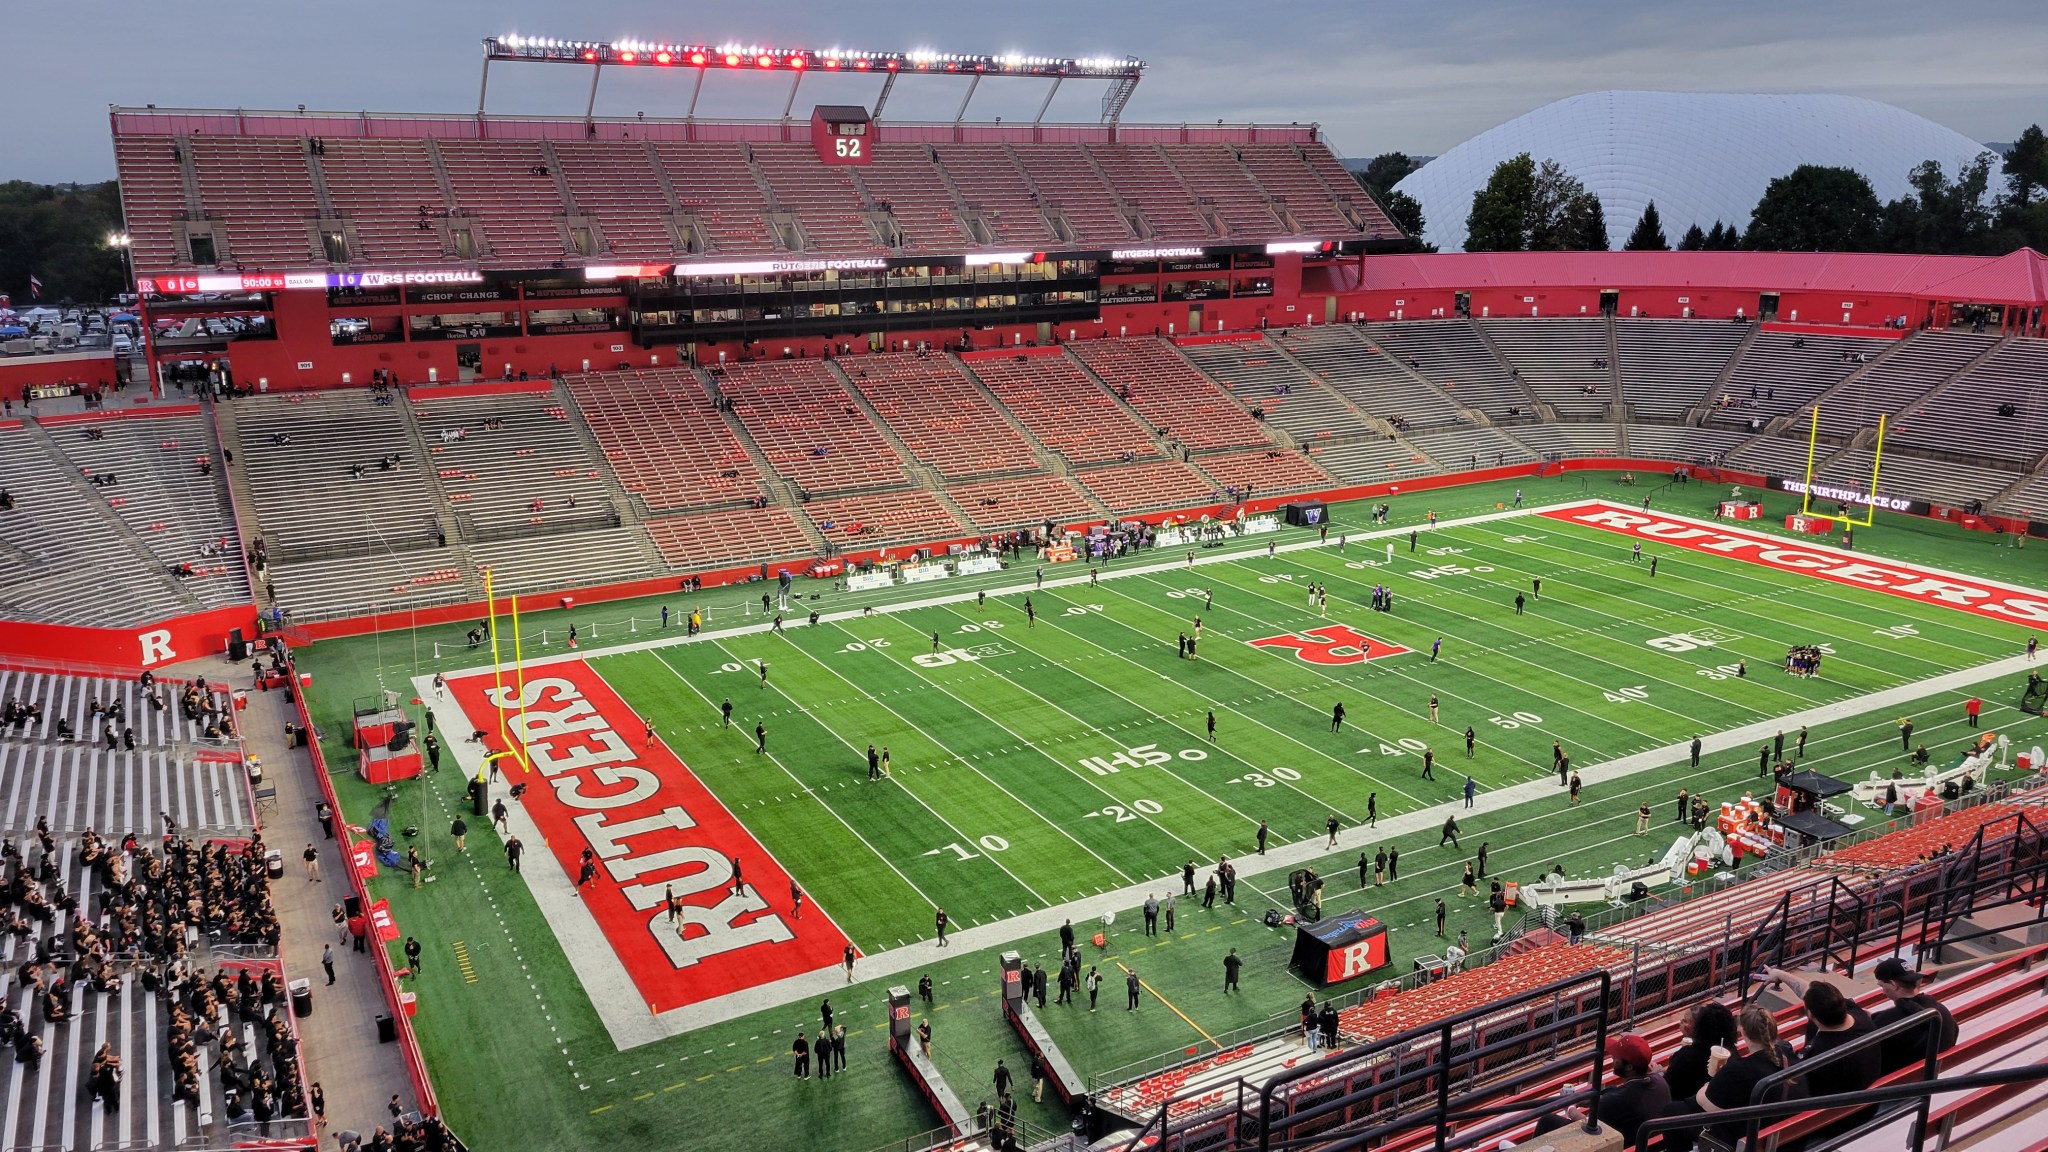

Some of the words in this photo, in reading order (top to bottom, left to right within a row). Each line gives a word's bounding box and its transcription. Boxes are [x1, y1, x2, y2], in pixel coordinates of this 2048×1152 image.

[836, 138, 861, 157] 52
[1112, 249, 1155, 259] RUTGERS
[1155, 248, 1203, 258] FOOTBALL
[772, 259, 826, 271] RUTGERS
[827, 258, 887, 269] FOOTBALL
[167, 279, 176, 290] 0
[243, 278, 272, 288] 90:00
[347, 276, 355, 285] 0
[366, 274, 381, 285] W
[405, 272, 483, 283] FOOTBALL
[459, 291, 499, 300] CHANGE
[580, 287, 622, 295] BOARDWALK
[1782, 480, 1807, 494] THE
[1809, 484, 1890, 507] BIRTHPLACE
[1891, 499, 1911, 511] OF
[1724, 504, 1735, 518] R
[1749, 506, 1758, 519] R
[1792, 517, 1805, 533] R
[1572, 511, 2048, 622] RUTGERS
[1872, 625, 1920, 639] 10
[138, 629, 177, 666] R
[845, 637, 892, 652] 20
[1244, 623, 1416, 665] R
[1602, 686, 1647, 704] 40
[1487, 710, 1544, 730] 50
[1377, 737, 1428, 758] 40
[1241, 766, 1302, 788] 30
[1101, 799, 1164, 823] 20
[484, 677, 797, 969] RUTGERS
[942, 835, 1010, 862] 10
[1342, 941, 1371, 978] R
[1006, 970, 1020, 983] R
[895, 1006, 909, 1021] R
